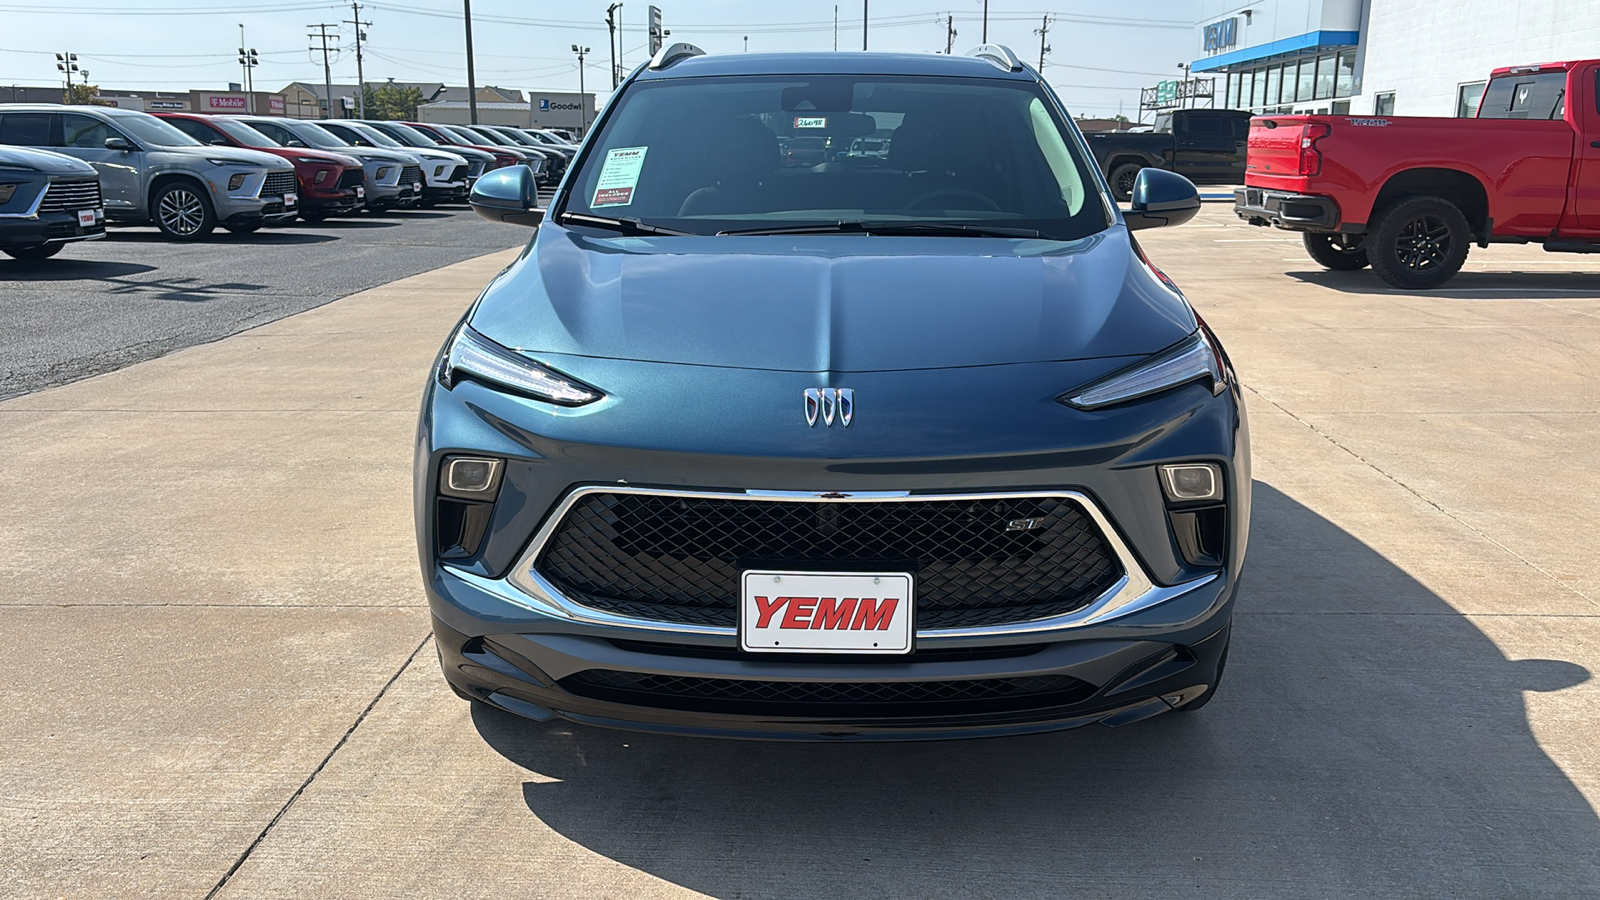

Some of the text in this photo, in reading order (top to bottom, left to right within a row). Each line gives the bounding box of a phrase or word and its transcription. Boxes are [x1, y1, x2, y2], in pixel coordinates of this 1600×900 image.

[1203, 17, 1237, 51] YEMM
[550, 102, 583, 110] Goodwi
[1006, 517, 1044, 531] ST
[754, 596, 900, 631] YEMM
